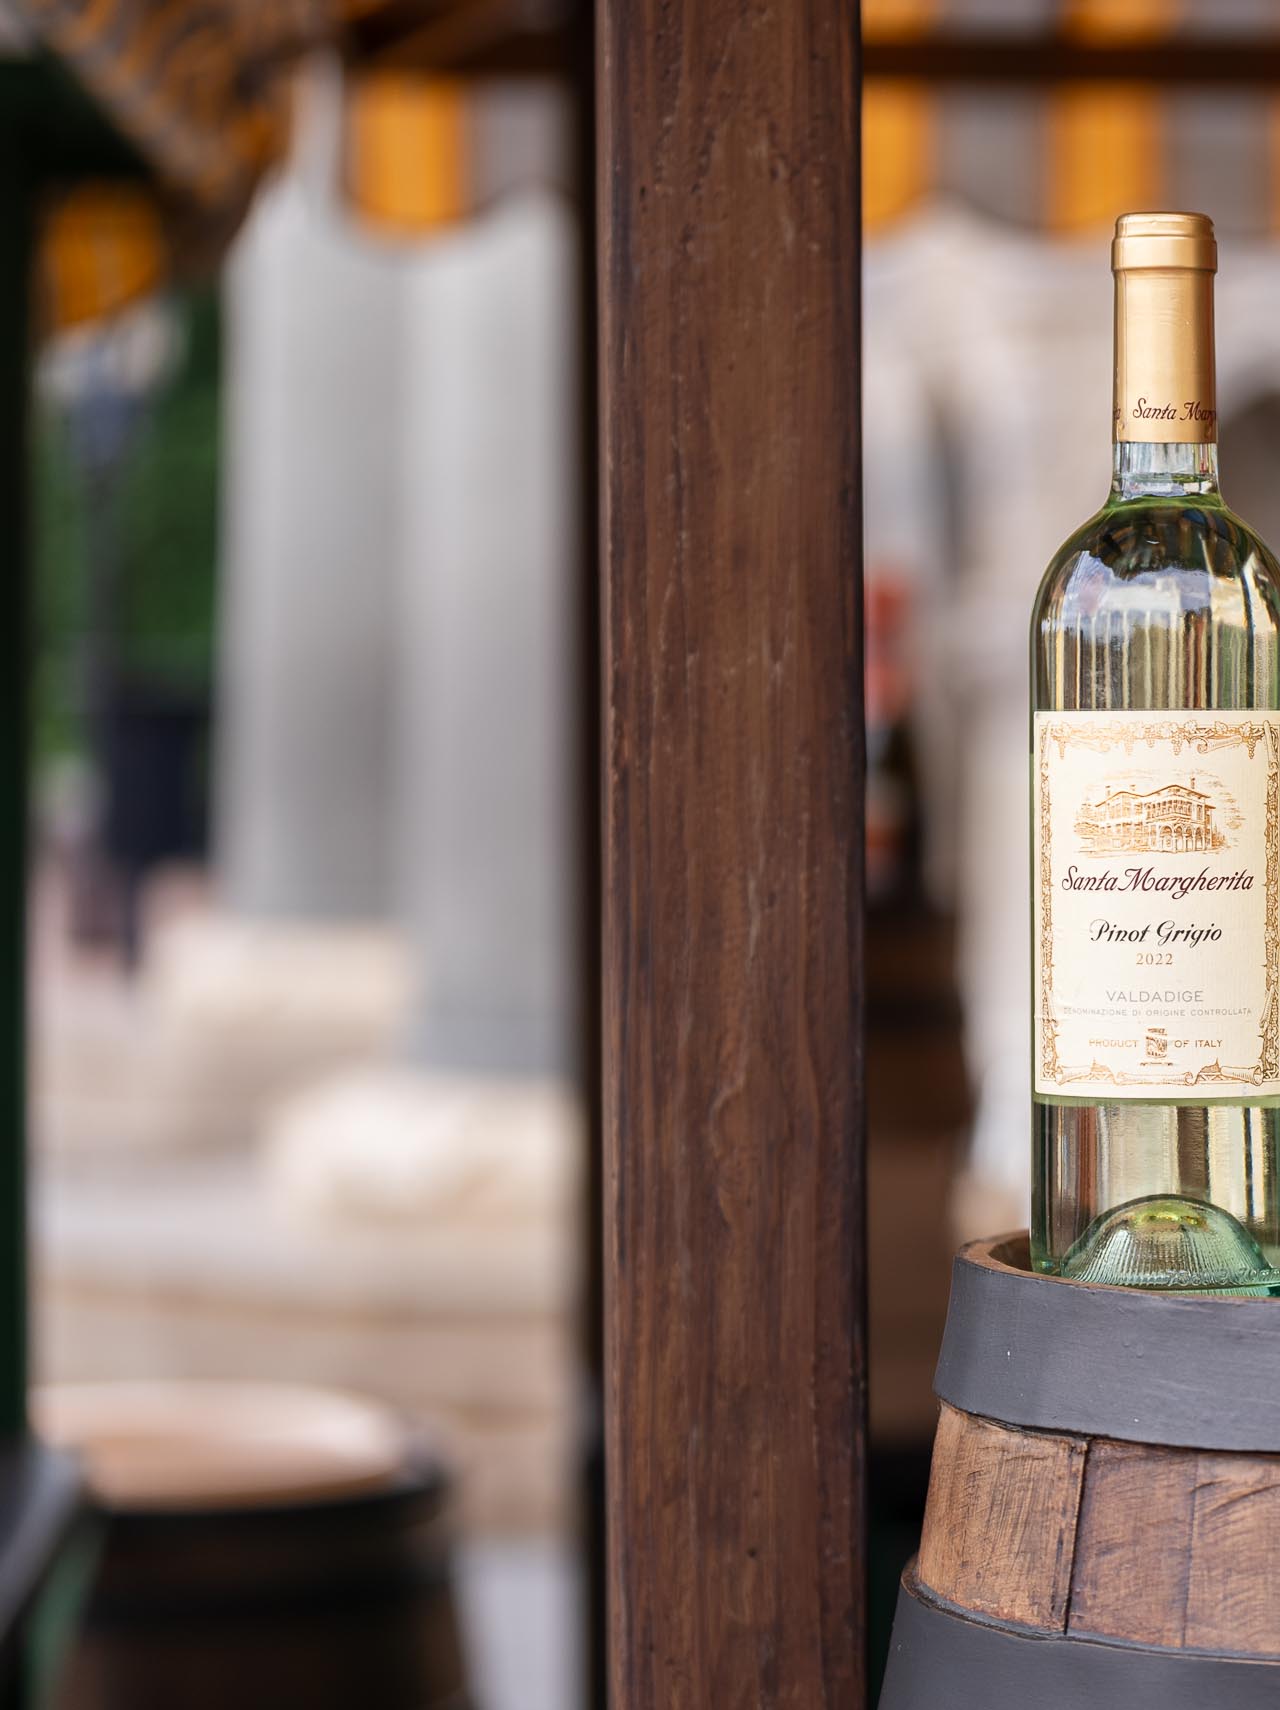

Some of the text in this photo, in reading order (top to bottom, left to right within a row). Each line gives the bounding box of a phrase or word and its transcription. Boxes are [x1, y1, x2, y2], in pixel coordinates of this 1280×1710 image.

[1132, 397, 1177, 420] Santa
[1061, 865, 1254, 900] Santa Margherita
[1089, 918, 1223, 949] Pinot Grigio
[1135, 952, 1174, 965] 2022
[1106, 990, 1204, 1003] VALDADIGE
[1063, 1007, 1128, 1017] DENOMINAZIONE
[1145, 1009, 1186, 1017] ORIGINE
[1190, 1007, 1252, 1017] CONTROLLATA
[1088, 1039, 1223, 1048] PRODUCT OF ITALY
